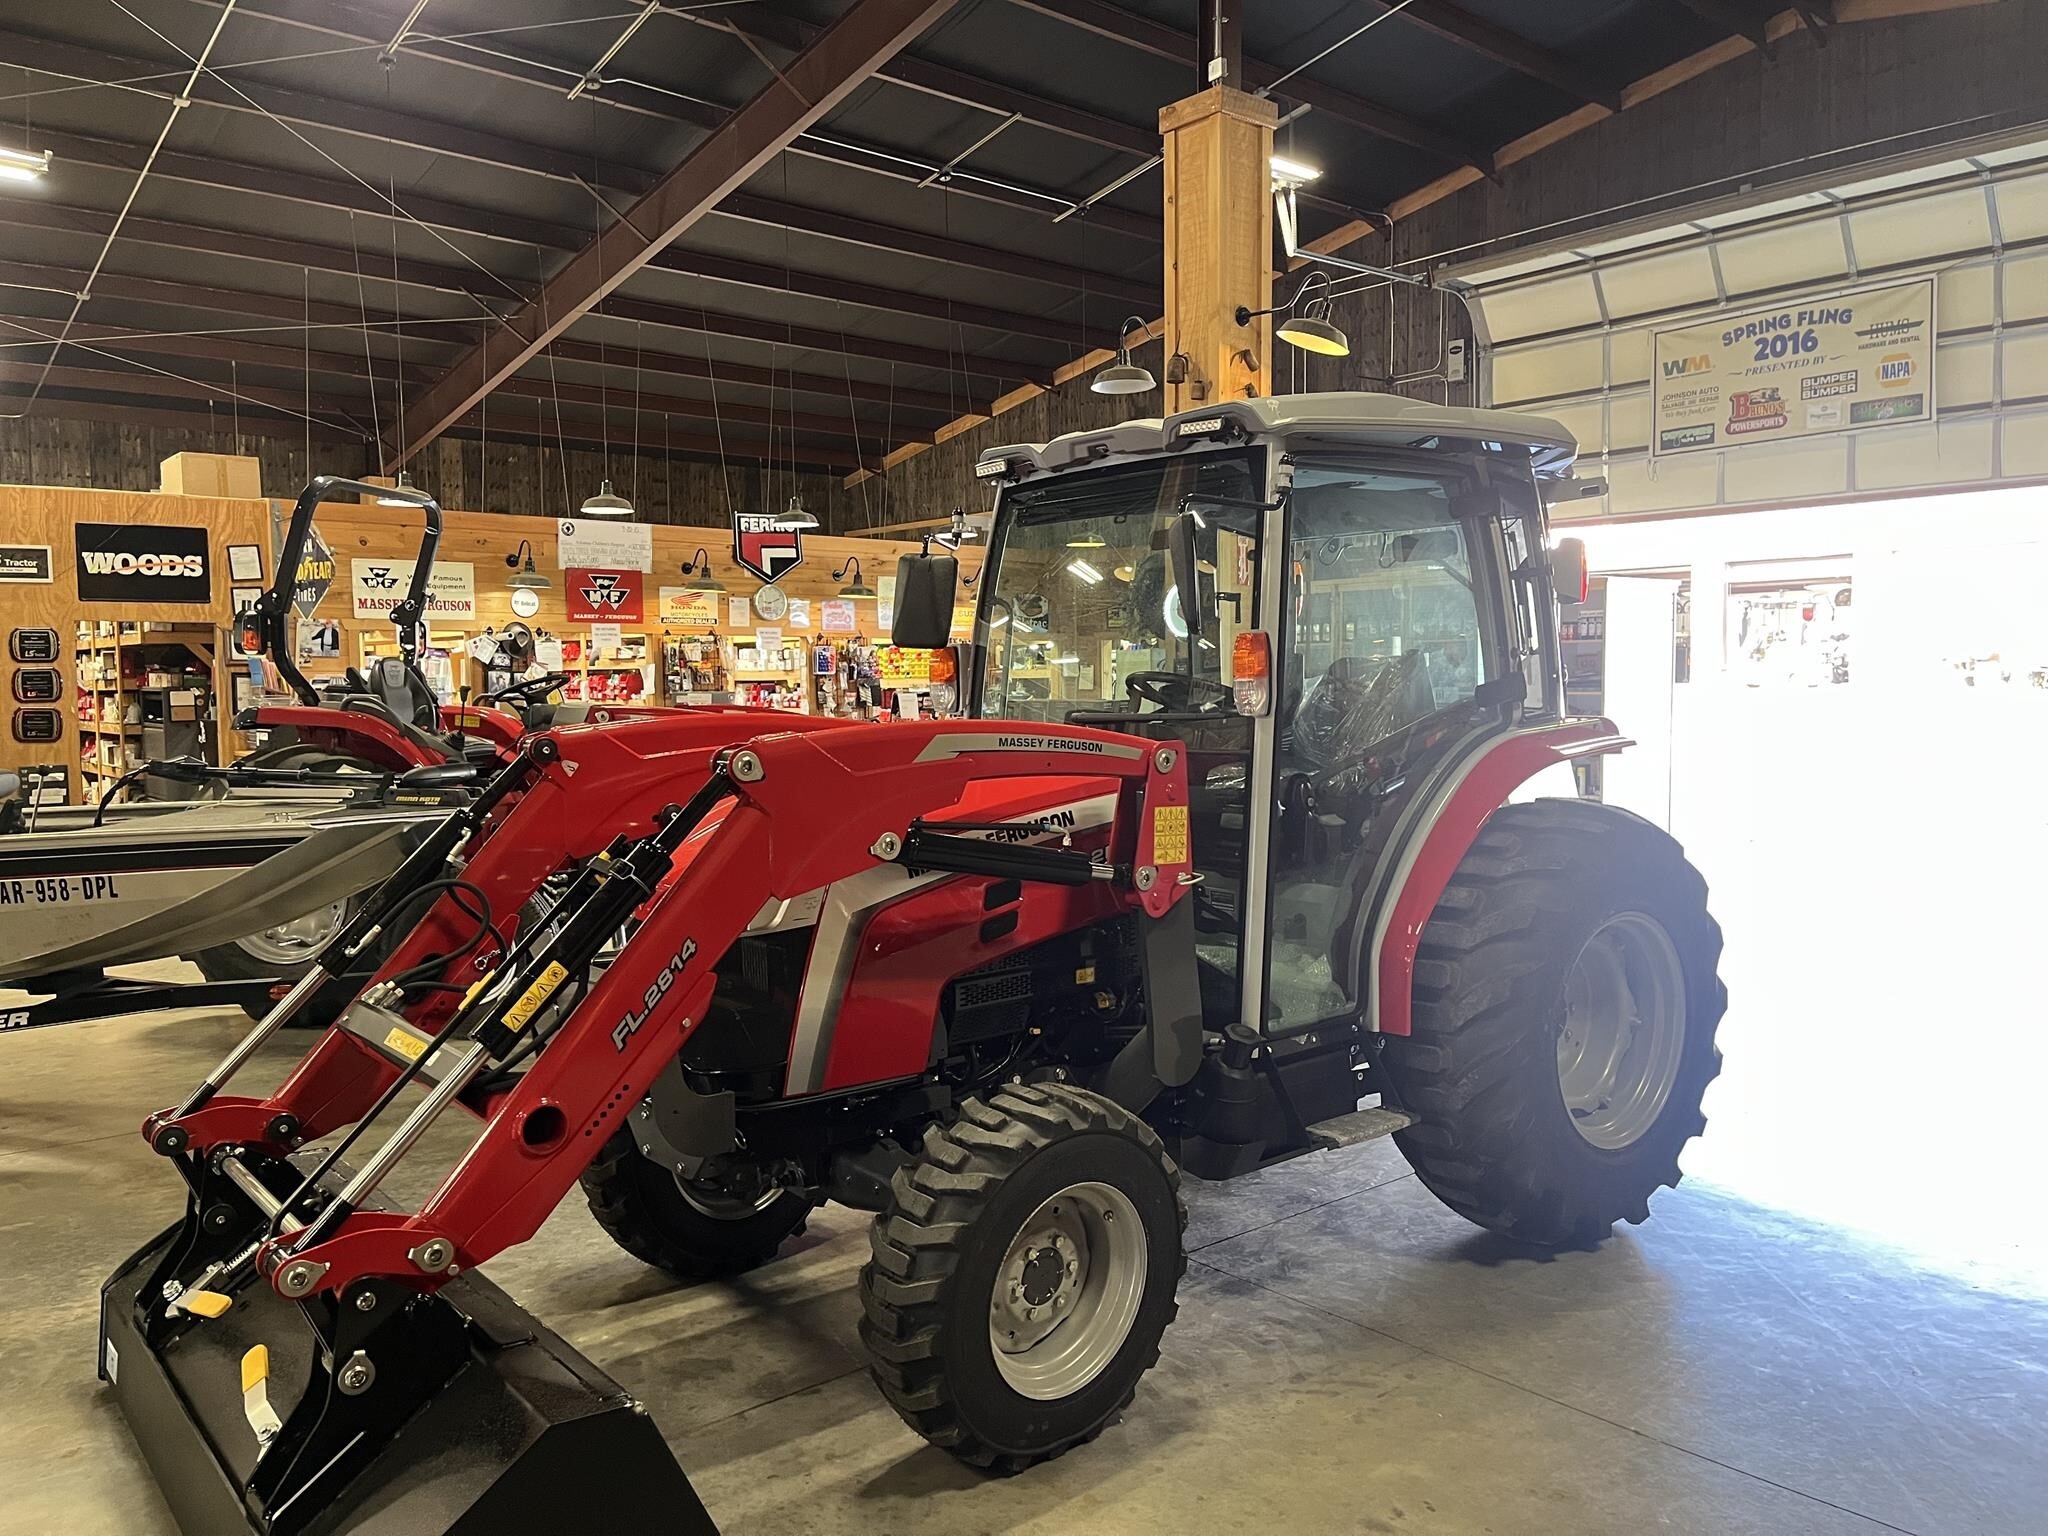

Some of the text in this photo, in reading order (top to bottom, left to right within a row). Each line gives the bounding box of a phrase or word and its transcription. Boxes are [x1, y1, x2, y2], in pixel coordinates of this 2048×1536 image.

[1722, 308, 1853, 347] SPRING FLING
[1754, 328, 1819, 361] 2016
[1662, 354, 1712, 377] WM
[1745, 356, 1828, 376] PRESENTED BY
[1881, 361, 1911, 380] NAPA
[1802, 371, 1856, 387] BUMPER
[1662, 386, 1720, 401] JOHNSON AUTO
[1802, 383, 1856, 400] BUMPER
[1729, 416, 1785, 433] POWERSPORTS
[741, 517, 795, 532] FERR
[4, 559, 38, 567] Tractor
[82, 551, 203, 577] WOODS
[427, 583, 466, 591] Equipment
[998, 737, 1103, 753] MASSEY FERGUSON
[0, 875, 119, 904] AR-958-DPL
[610, 937, 698, 1052] FL.2814
